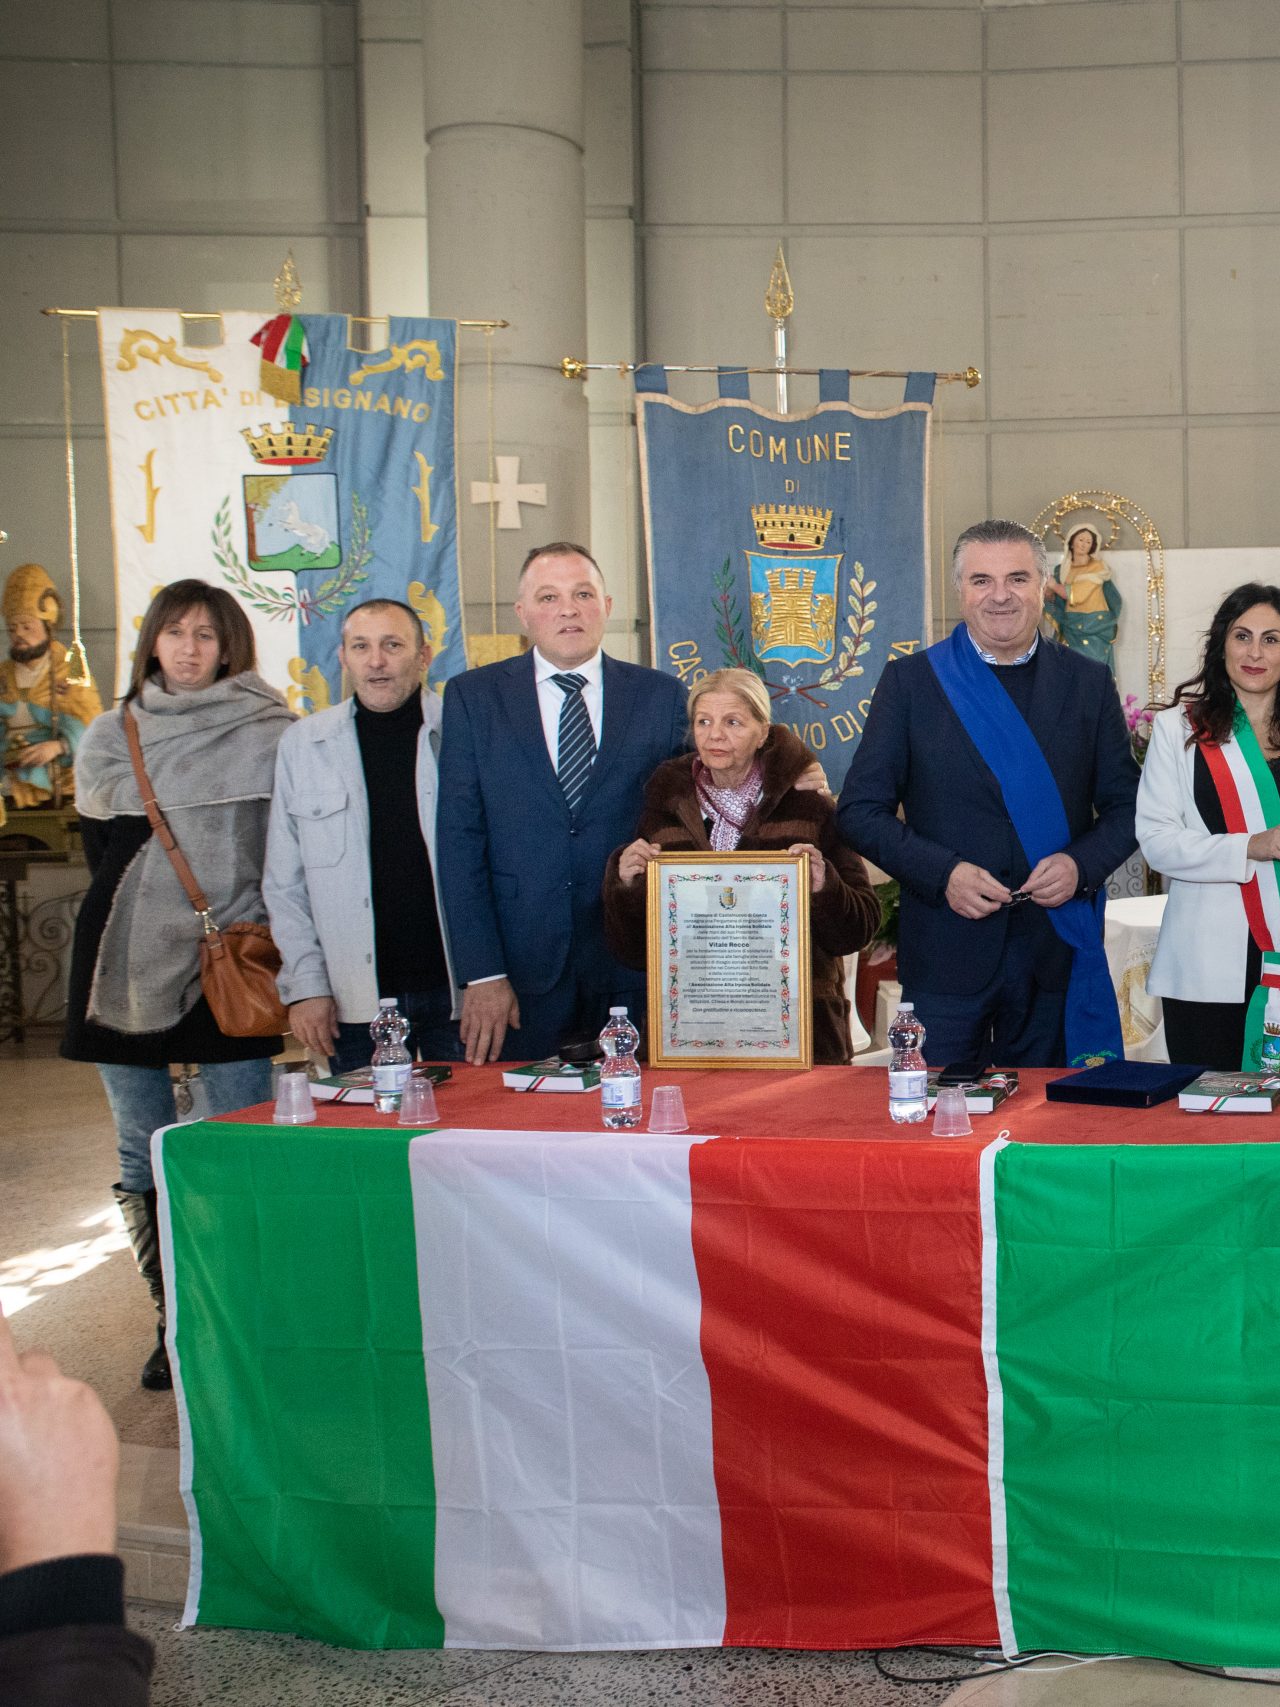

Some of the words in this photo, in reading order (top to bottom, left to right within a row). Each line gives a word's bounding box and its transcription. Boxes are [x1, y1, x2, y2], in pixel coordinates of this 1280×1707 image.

[134, 388, 228, 421] CITTA'
[240, 390, 263, 407] DI
[274, 388, 431, 423] SIGNANO
[728, 423, 852, 465] COMUNE
[785, 479, 800, 494] DI
[830, 710, 863, 742] DI
